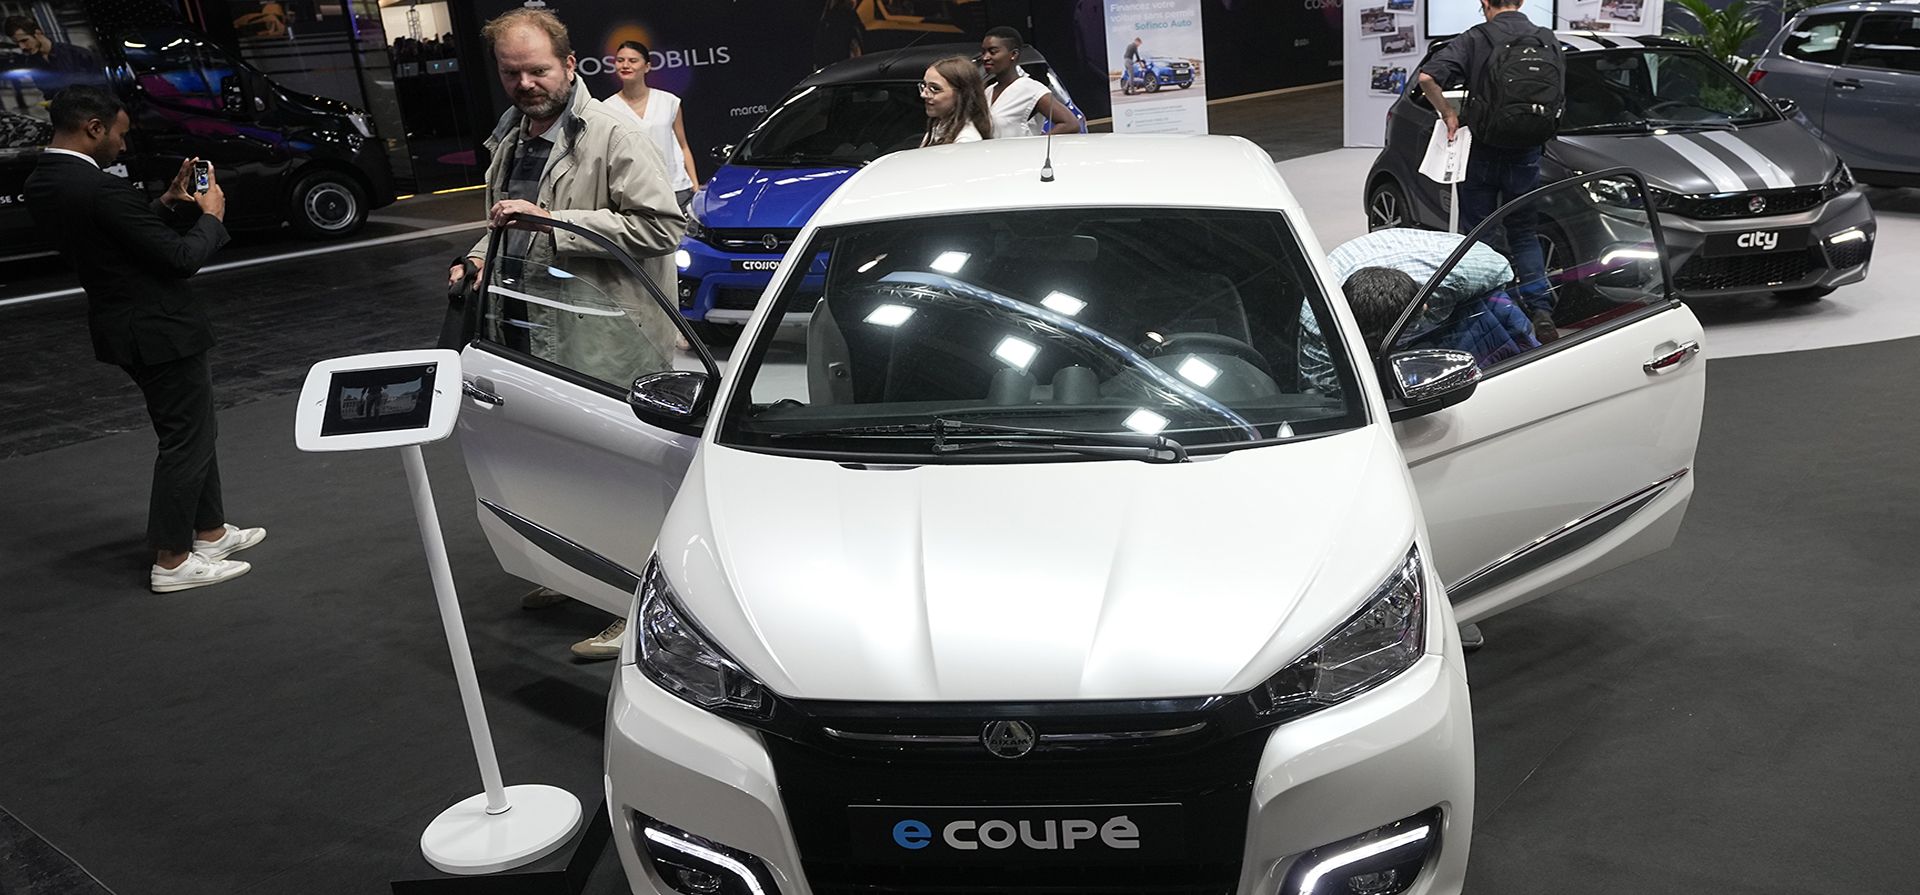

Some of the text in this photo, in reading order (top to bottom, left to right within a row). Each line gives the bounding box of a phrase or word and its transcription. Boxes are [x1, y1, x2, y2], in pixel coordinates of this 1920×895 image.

[1152, 1, 1175, 9] votre
[1135, 21, 1168, 30] Sofinco
[1171, 19, 1192, 27] Auto
[1737, 231, 1778, 250] city
[892, 815, 1139, 849] e coupé
